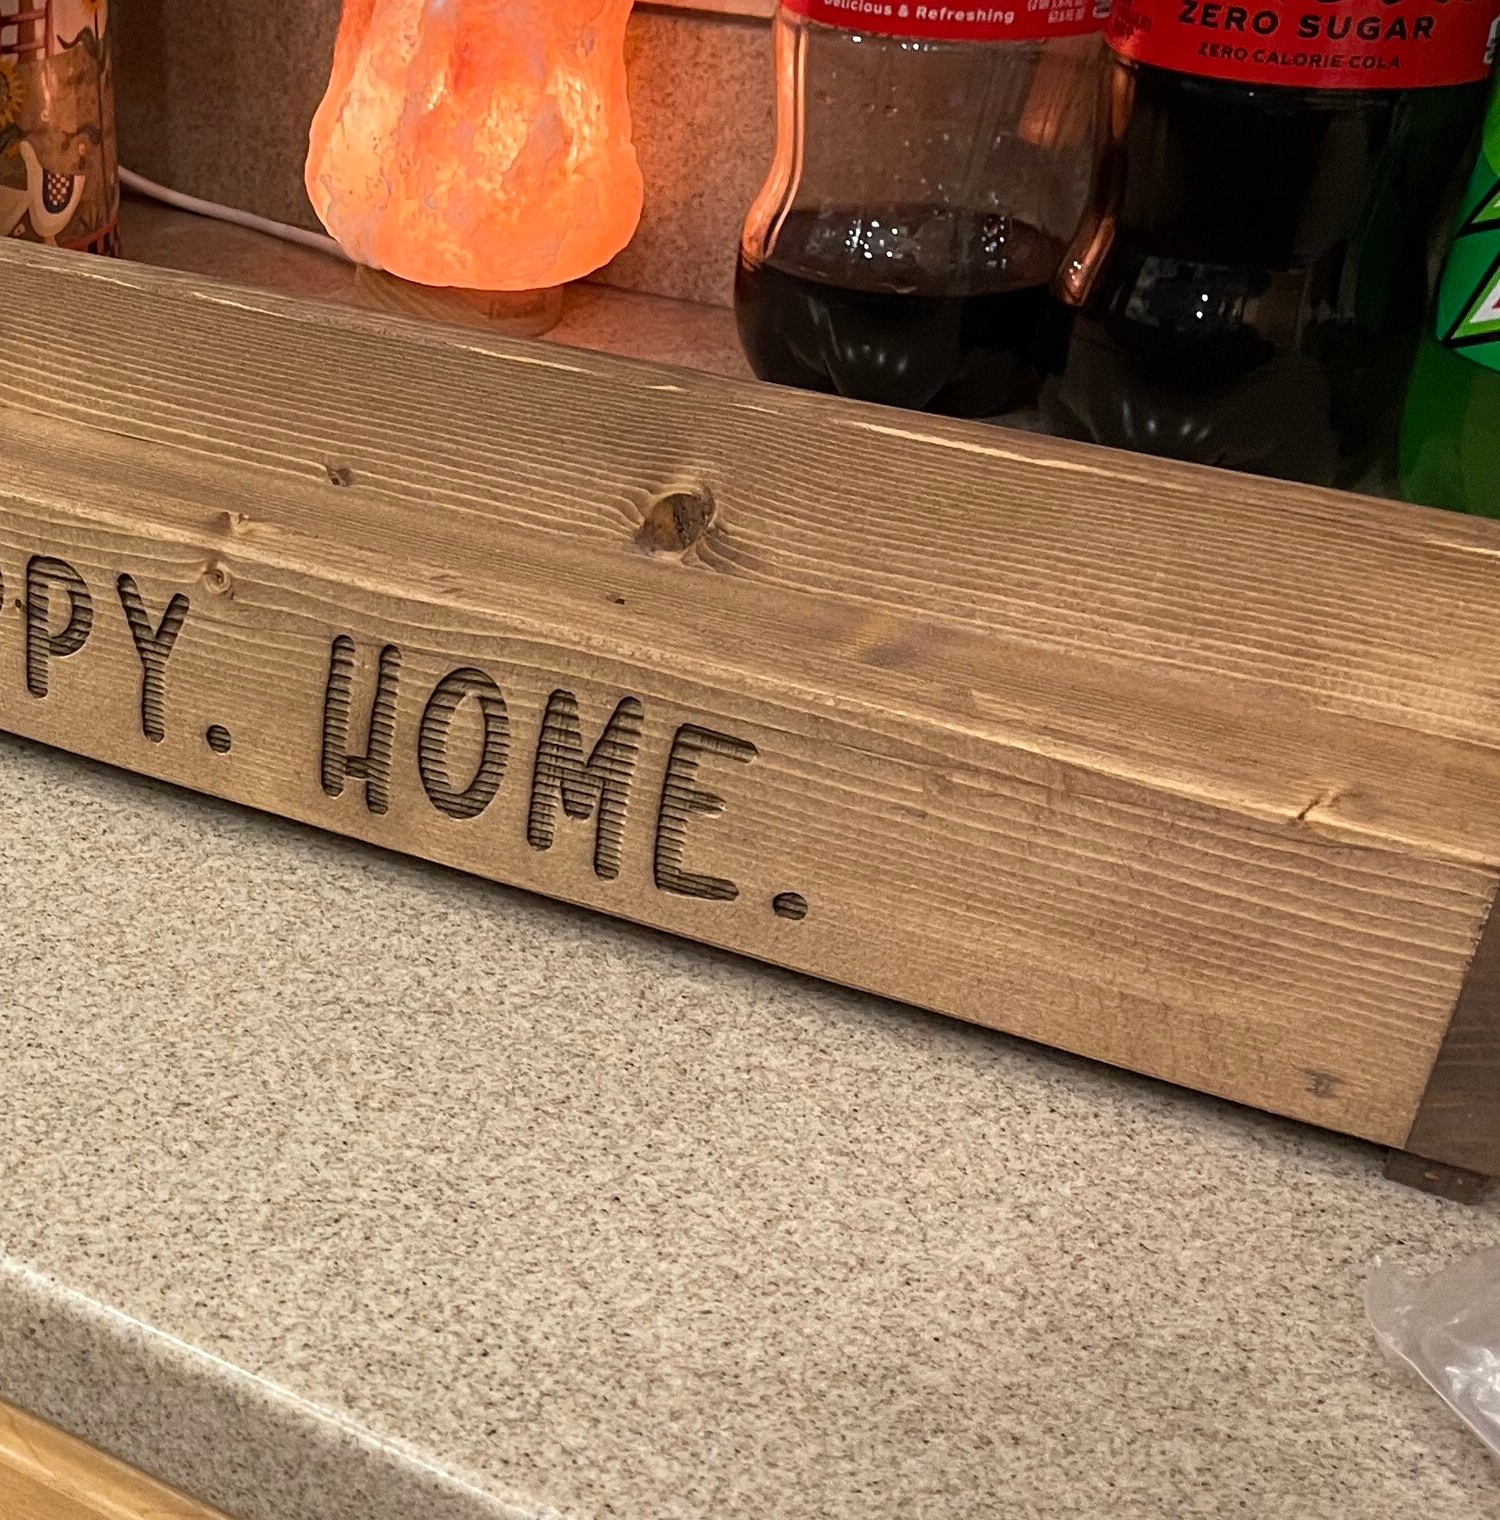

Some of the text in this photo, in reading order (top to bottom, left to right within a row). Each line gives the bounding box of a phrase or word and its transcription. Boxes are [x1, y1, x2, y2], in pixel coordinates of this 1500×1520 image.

[898, 4, 909, 18] &
[916, 6, 1014, 25] Refreshing
[1177, 1, 1280, 36] ZERO
[1297, 14, 1435, 42] SUGAR
[1198, 42, 1400, 69] ZERO CALORIE COLA
[321, 634, 808, 921] HOME.
